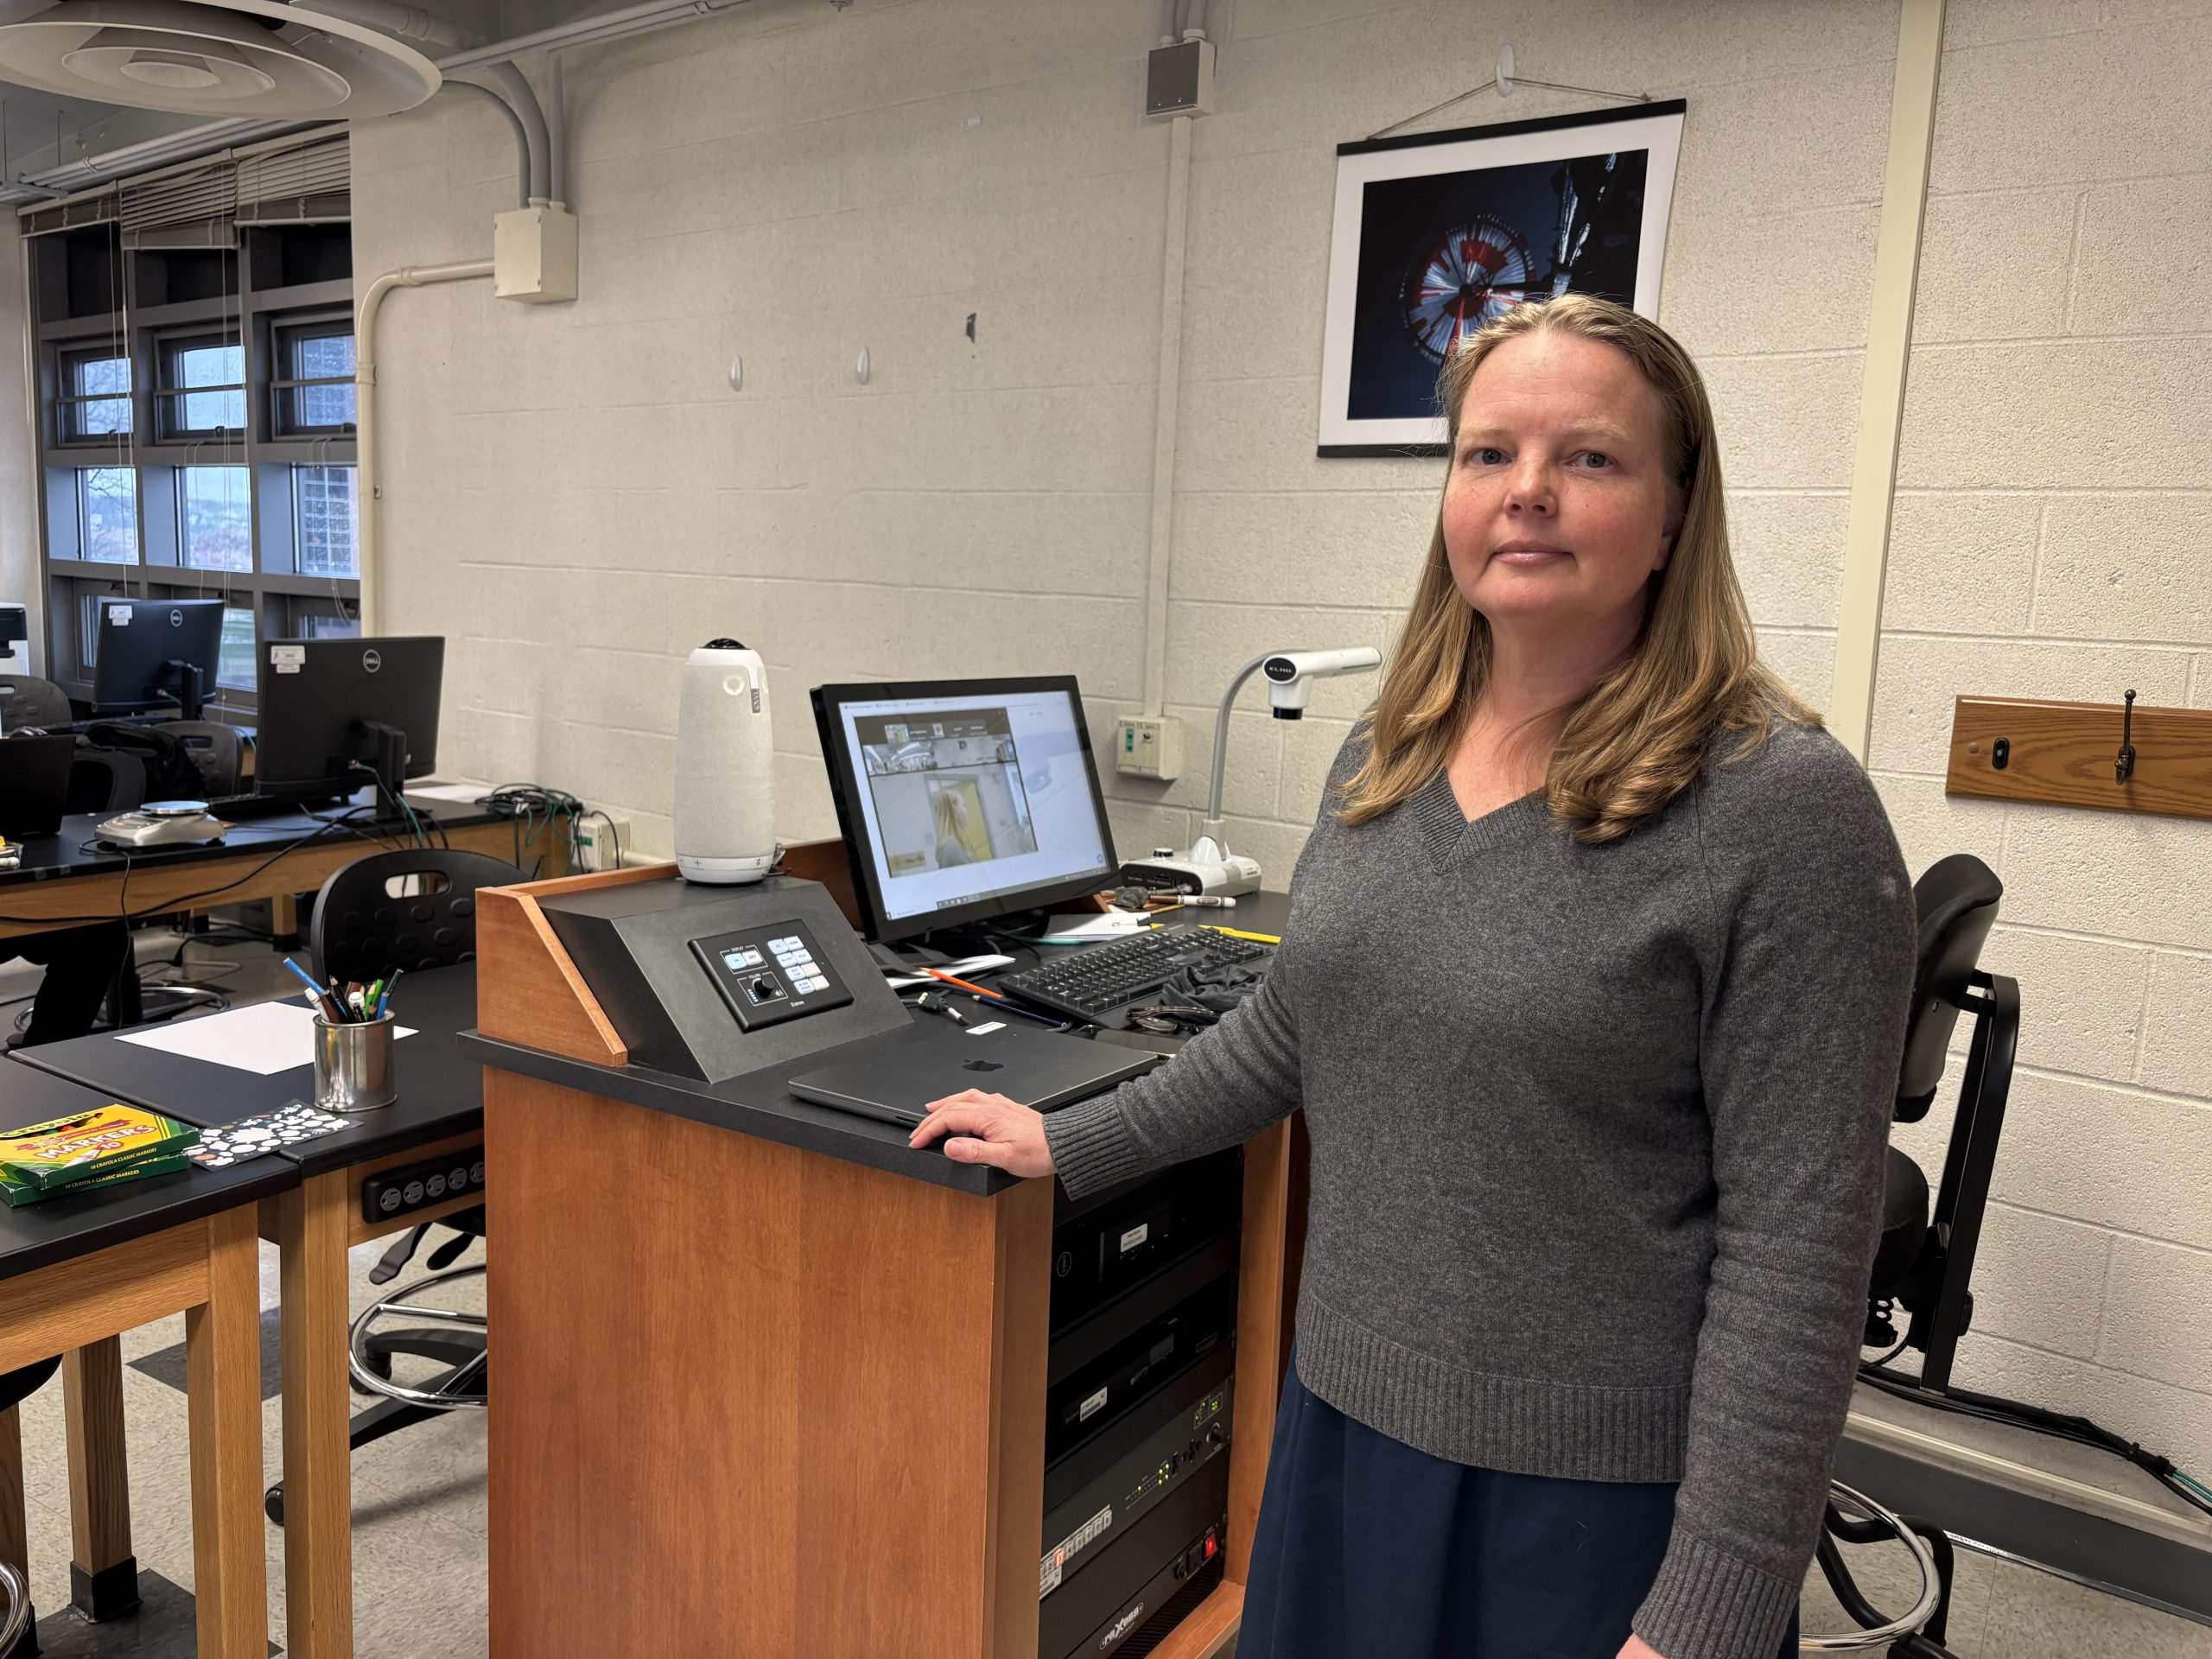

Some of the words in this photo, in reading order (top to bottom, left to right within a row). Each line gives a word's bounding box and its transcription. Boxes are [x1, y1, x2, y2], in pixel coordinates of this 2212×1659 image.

[2, 1114, 90, 1136] Crayola
[35, 1125, 156, 1159] MARKERS
[100, 1141, 121, 1150] 10
[96, 1159, 118, 1169] CRAYOLA
[118, 1153, 137, 1162] CLASSIC
[136, 1147, 157, 1157] MARKERS
[71, 1179, 95, 1188] CRAYOLA
[95, 1174, 116, 1183] CLASSIC
[116, 1169, 140, 1179] MARKERS
